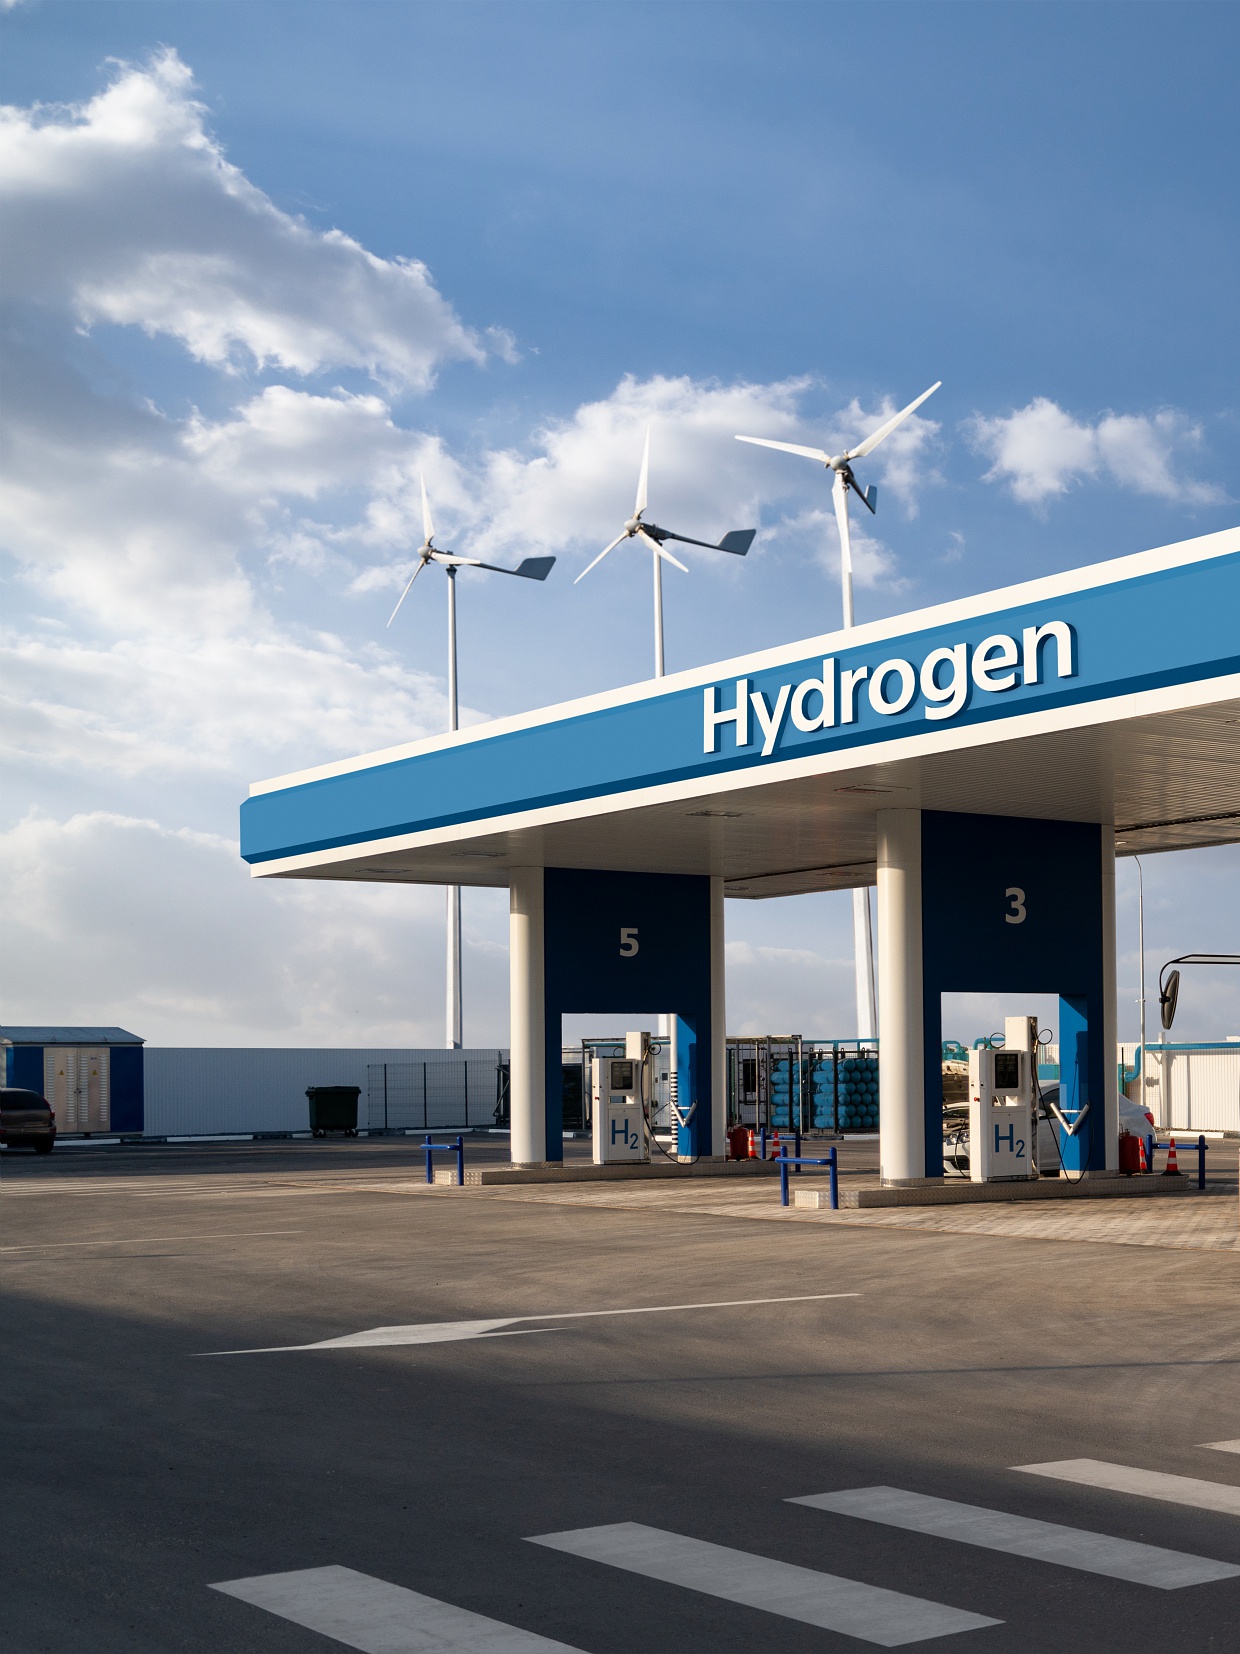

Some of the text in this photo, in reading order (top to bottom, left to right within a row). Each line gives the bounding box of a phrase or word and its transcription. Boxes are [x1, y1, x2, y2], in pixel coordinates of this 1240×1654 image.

[703, 619, 1076, 757] Hydrogen
[1005, 887, 1027, 924] 3
[619, 927, 639, 957] 5
[611, 1118, 639, 1150] H2
[994, 1123, 1026, 1158] H2
